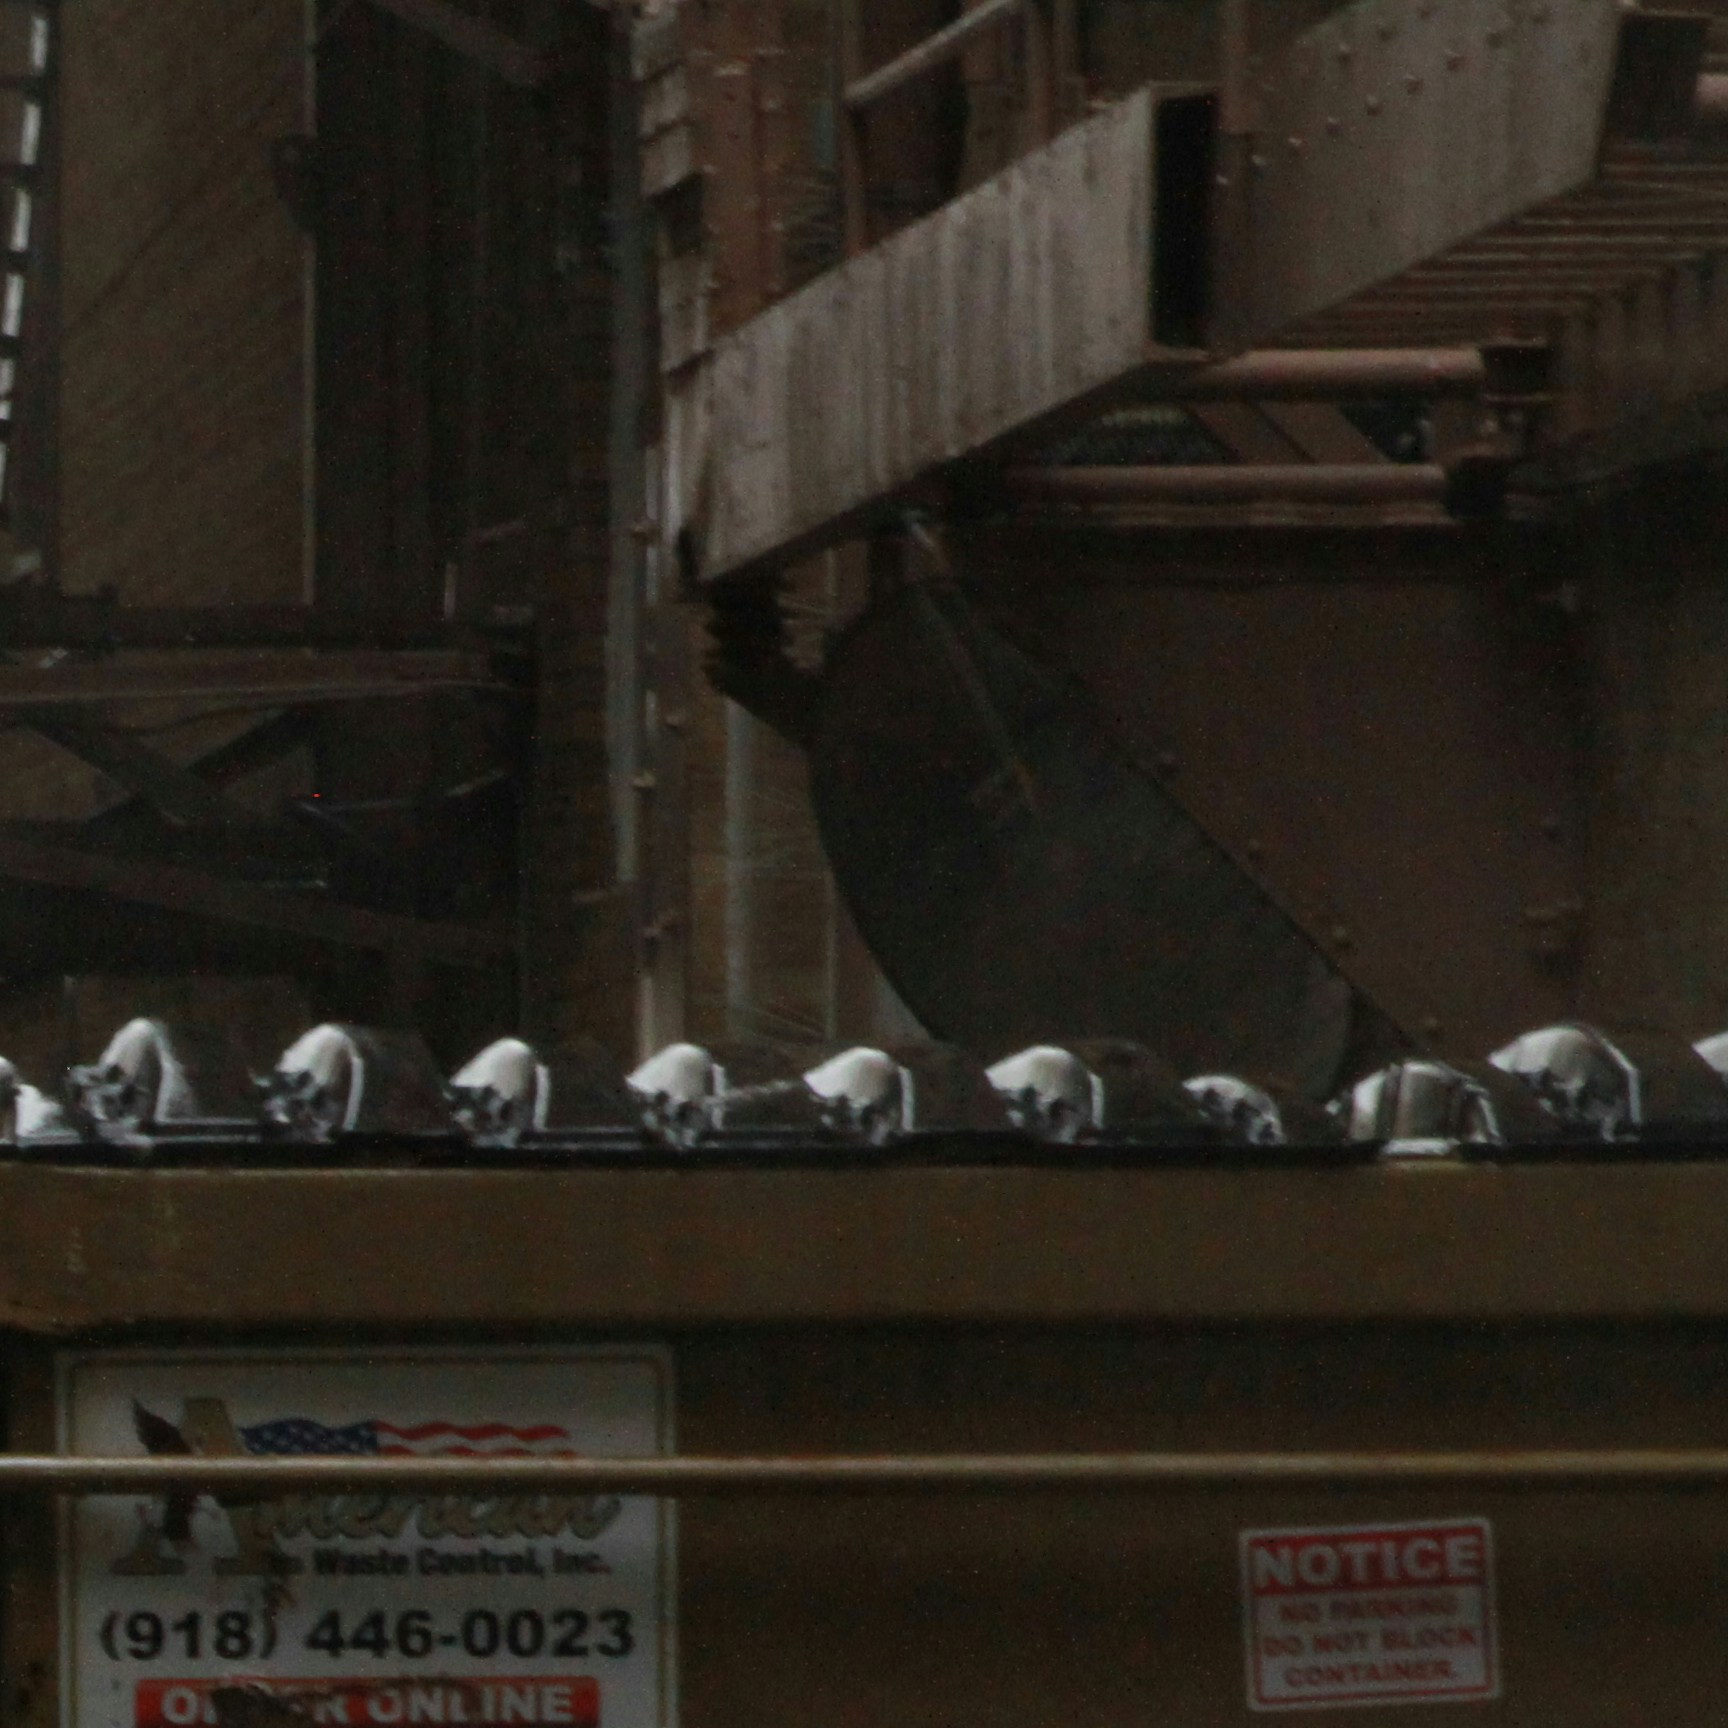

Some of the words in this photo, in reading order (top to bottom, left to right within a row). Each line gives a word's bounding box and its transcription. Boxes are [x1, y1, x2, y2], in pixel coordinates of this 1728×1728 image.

[312, 1548, 409, 1575] Waste
[1254, 1533, 1482, 1588] NOTICE
[99, 1610, 277, 1660] (918)
[304, 1608, 636, 1660] 446-0023
[1312, 1631, 1369, 1653] NOT
[1380, 1627, 1477, 1650] BLOCK
[366, 1684, 574, 1724] ONLINE
